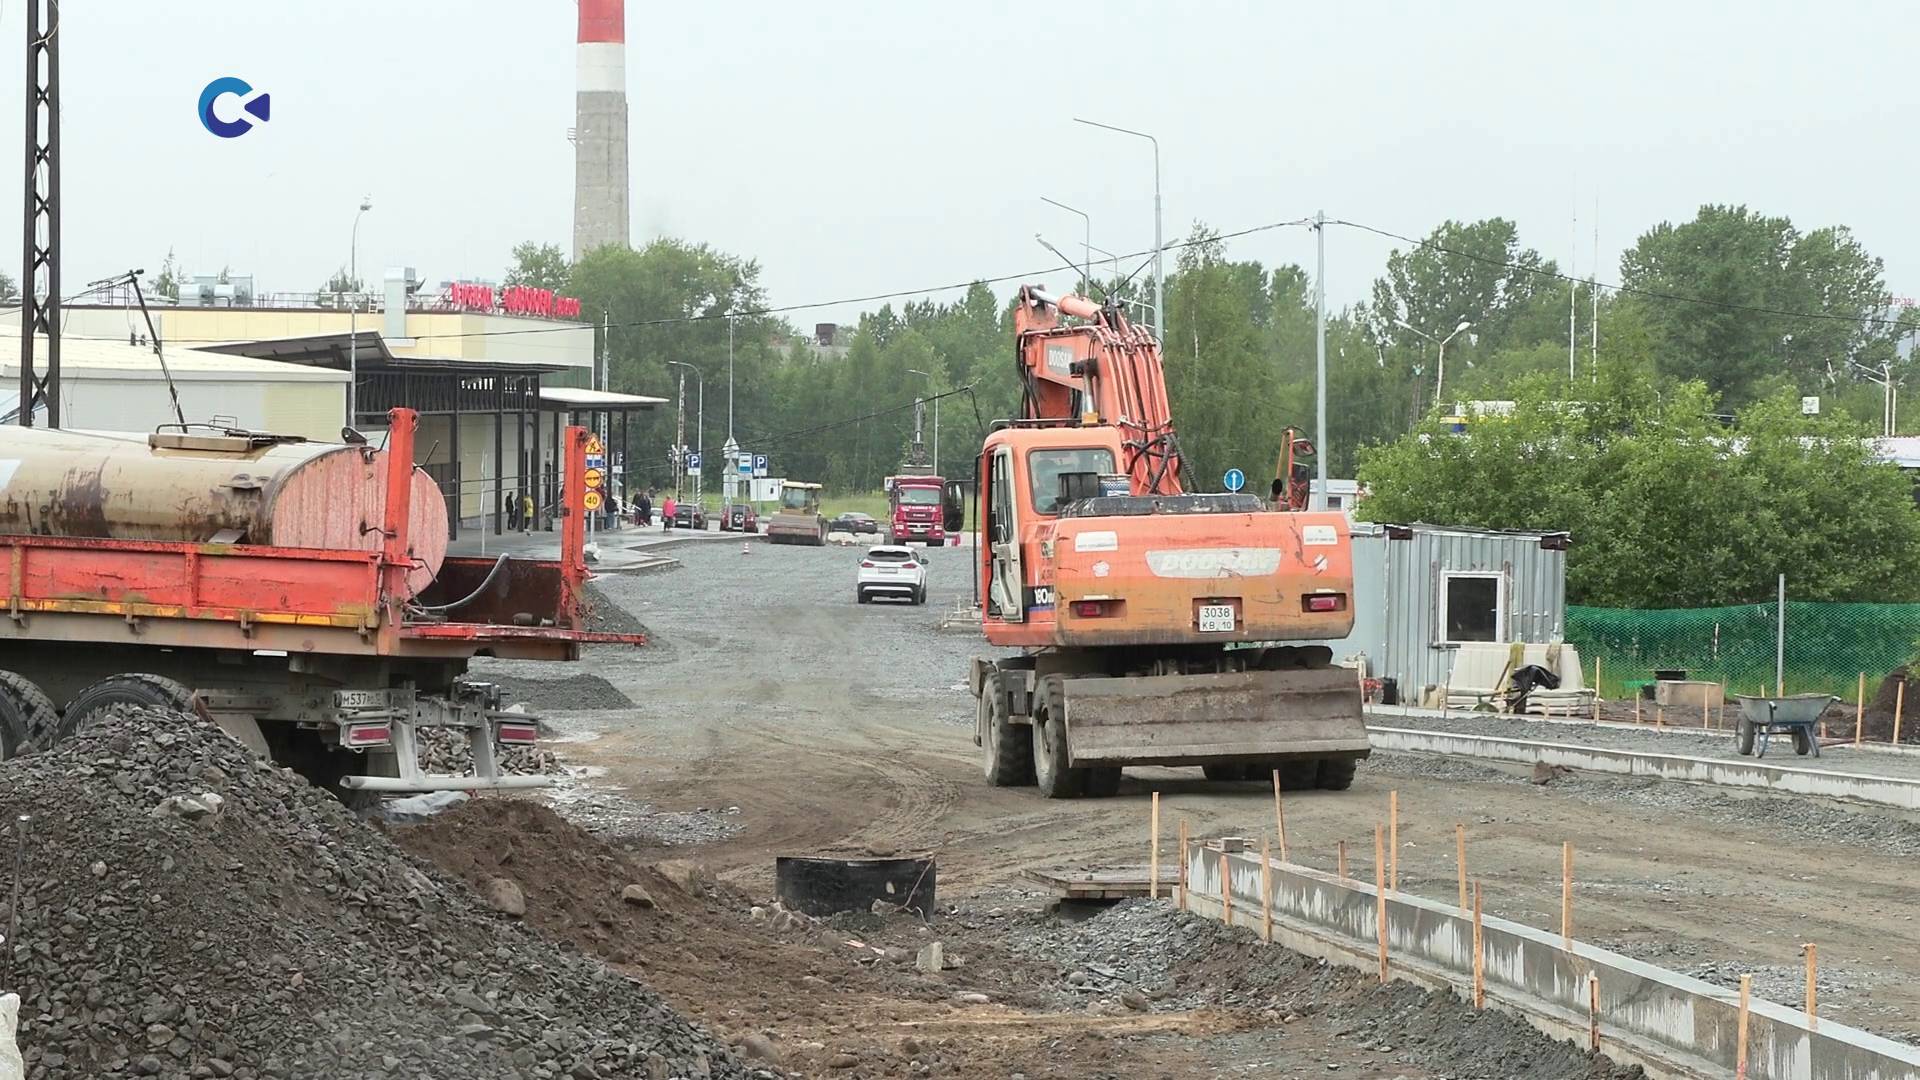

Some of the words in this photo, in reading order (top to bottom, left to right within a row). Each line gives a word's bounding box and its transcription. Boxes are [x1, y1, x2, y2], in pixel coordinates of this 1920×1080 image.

[586, 496, 598, 505] 40
[1204, 607, 1231, 618] 3038
[1222, 621, 1232, 630] 10
